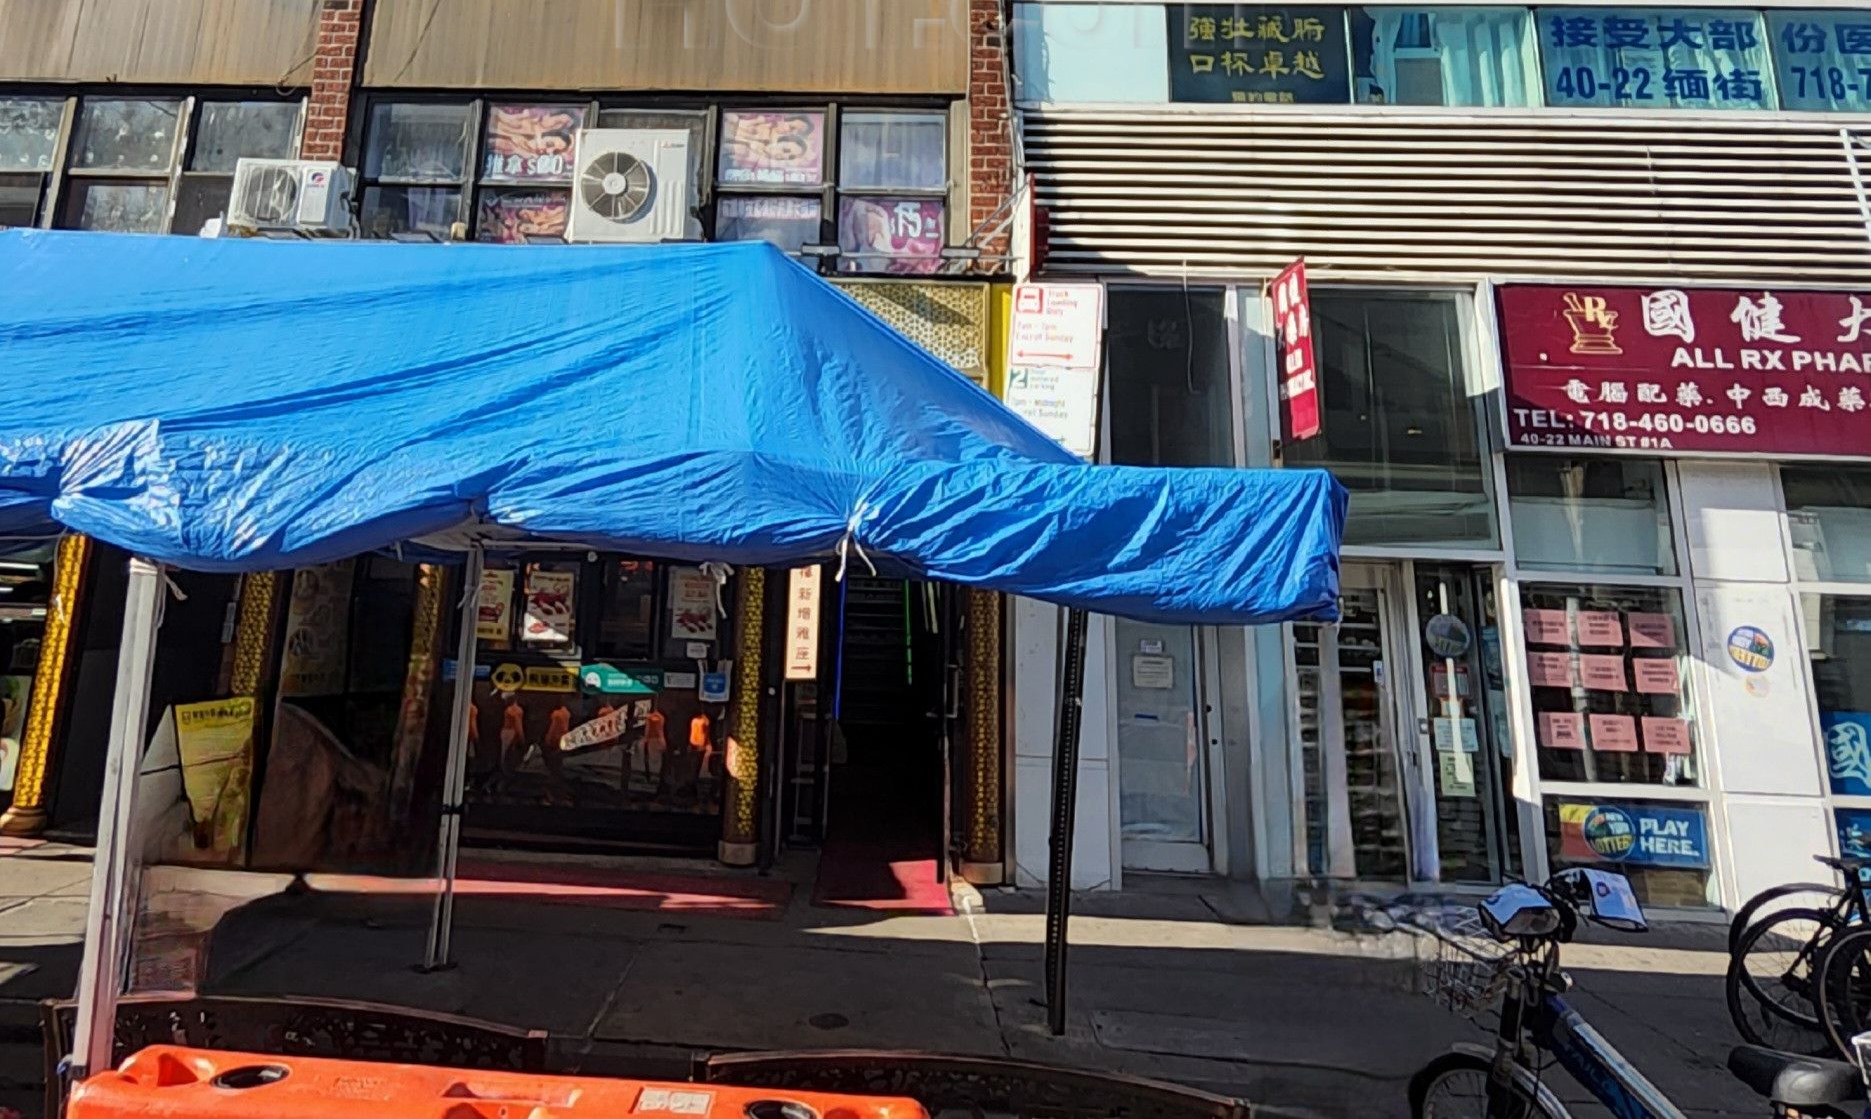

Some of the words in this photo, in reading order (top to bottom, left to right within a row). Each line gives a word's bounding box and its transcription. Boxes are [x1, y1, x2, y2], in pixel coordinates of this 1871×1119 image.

[1556, 67, 1653, 100] 40-22
[1662, 69, 1763, 100] 缅街
[1671, 347, 1735, 369] ALL
[1740, 349, 1787, 371] RX
[1513, 408, 1574, 429] TEL:
[1579, 410, 1757, 434] 718-460-0666
[1520, 433, 1565, 445] 40-22
[1568, 434, 1612, 447] MAIN
[1615, 436, 1637, 448] ST
[1639, 817, 1689, 837] PLAY
